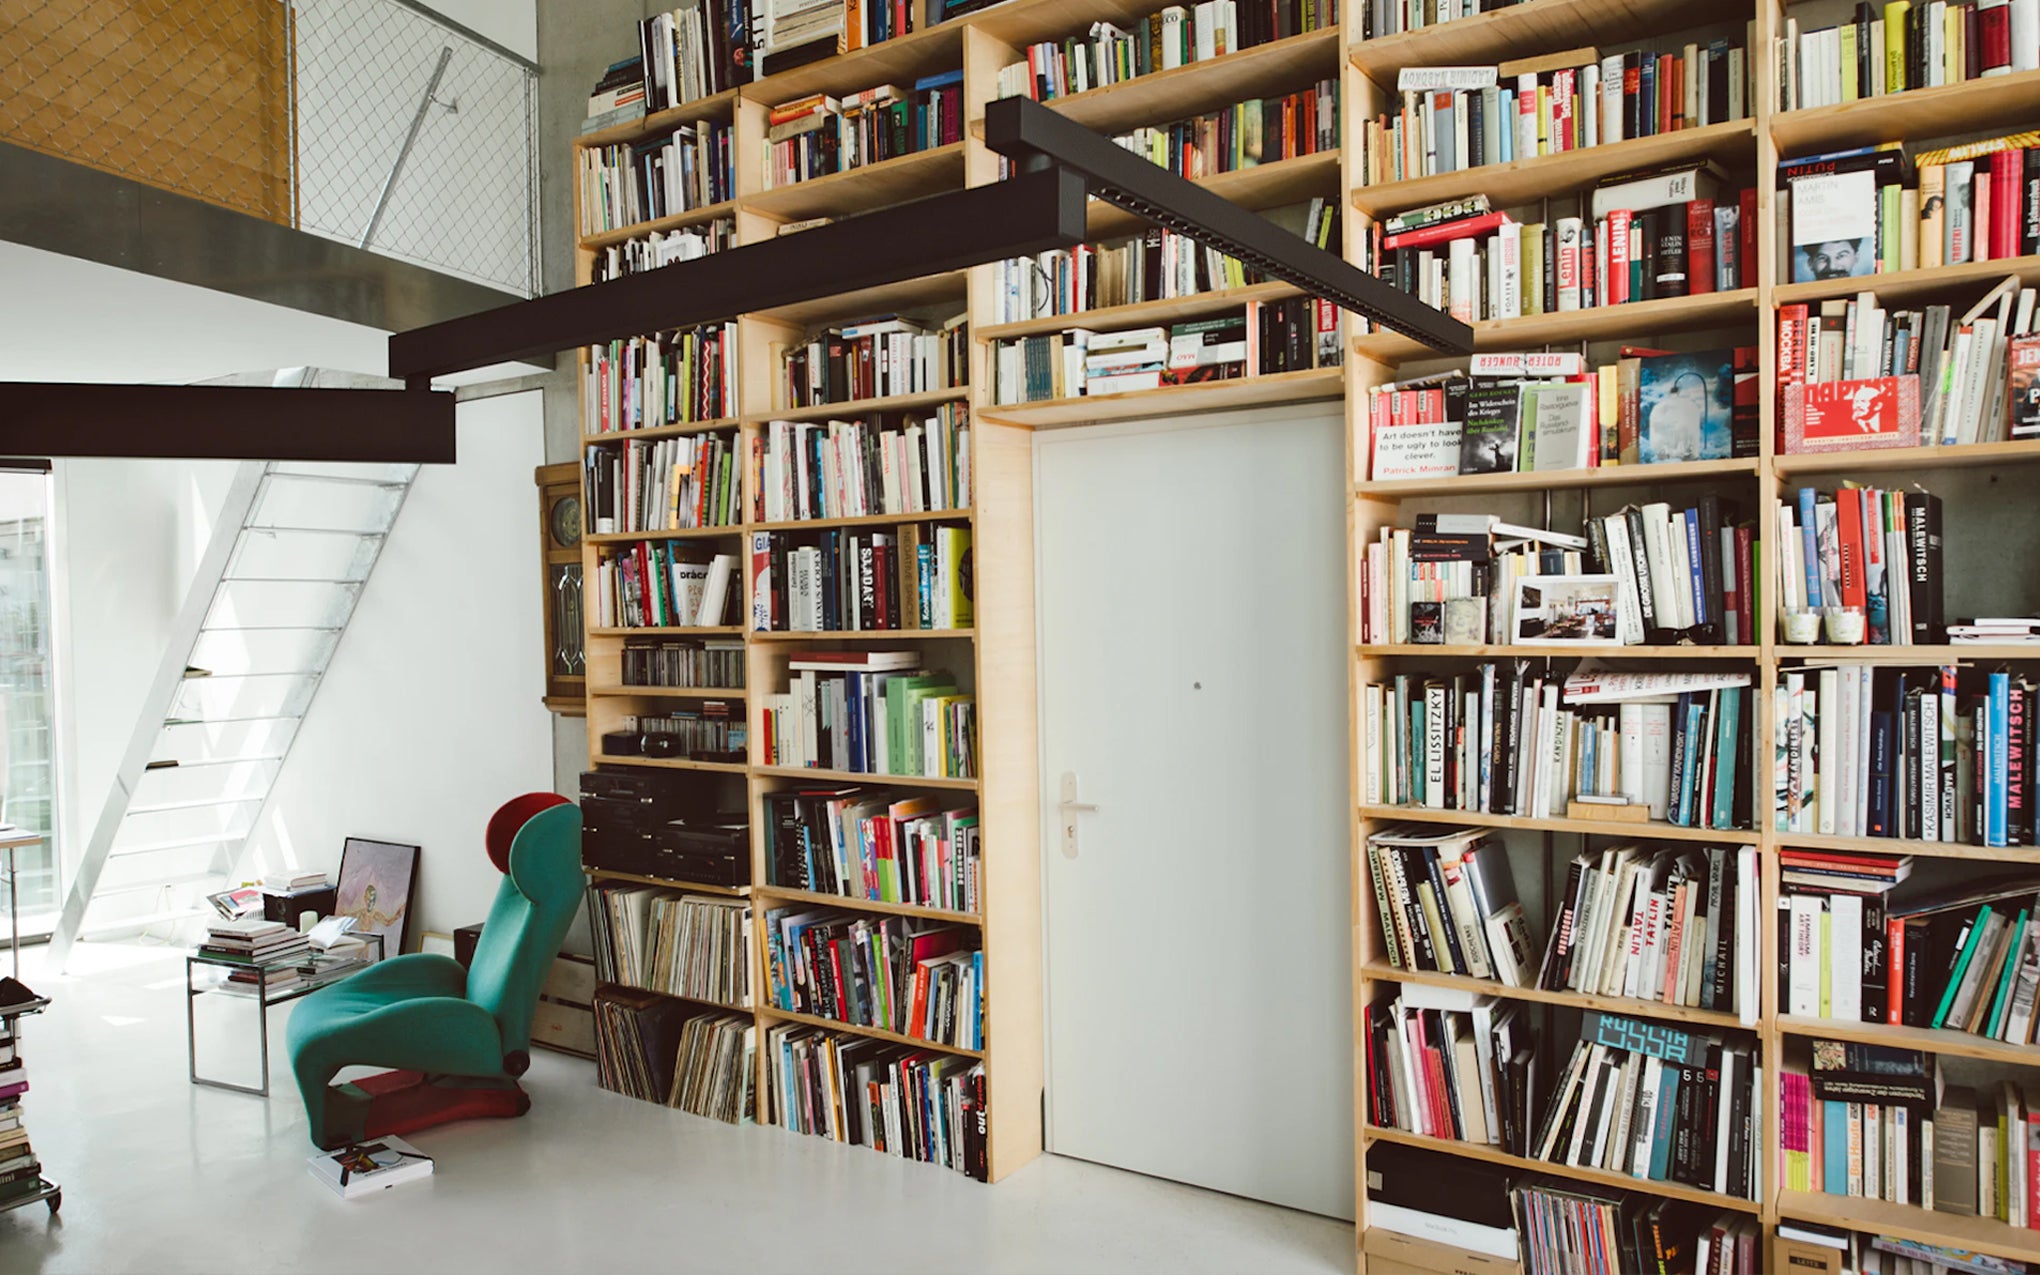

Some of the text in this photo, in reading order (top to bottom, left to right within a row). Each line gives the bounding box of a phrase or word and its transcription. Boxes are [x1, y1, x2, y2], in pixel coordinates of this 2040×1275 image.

[1786, 160, 1836, 177] PUTIN
[1611, 219, 1627, 264] LENIN
[1558, 247, 1573, 289] Lenin
[1480, 354, 1562, 367] ROTER HUNGER
[1380, 442, 1389, 450] to
[1391, 441, 1404, 450] be
[1406, 441, 1427, 452] ugly
[1430, 441, 1439, 449] to
[1382, 429, 1462, 441] Art doesn't have
[1405, 451, 1436, 461] clever.
[1383, 464, 1456, 475] Patrick Mimran
[1914, 507, 1927, 582] MALEWITSCH
[1430, 690, 1442, 783] EL LISSITZKY
[2008, 689, 2023, 809] MALEWITSCH
[1924, 701, 1935, 832] KASIMIR MALEWITSCH
[1944, 772, 1954, 819] MALEVICH
[1370, 850, 1385, 901] МАЛЕВИЧ
[1645, 899, 1659, 947] TATLIN
[1664, 881, 1679, 931] TATLIN
[1383, 912, 1398, 964] MALEVICH
[1631, 911, 1644, 956] TATLIN
[1670, 920, 1681, 951] TATLIN
[1715, 939, 1728, 995] MICHAIL
[1683, 1069, 1692, 1081] 5
[1696, 1071, 1705, 1083] 5
[976, 1110, 987, 1136] out
[1850, 1120, 1860, 1177] Bis Heute
